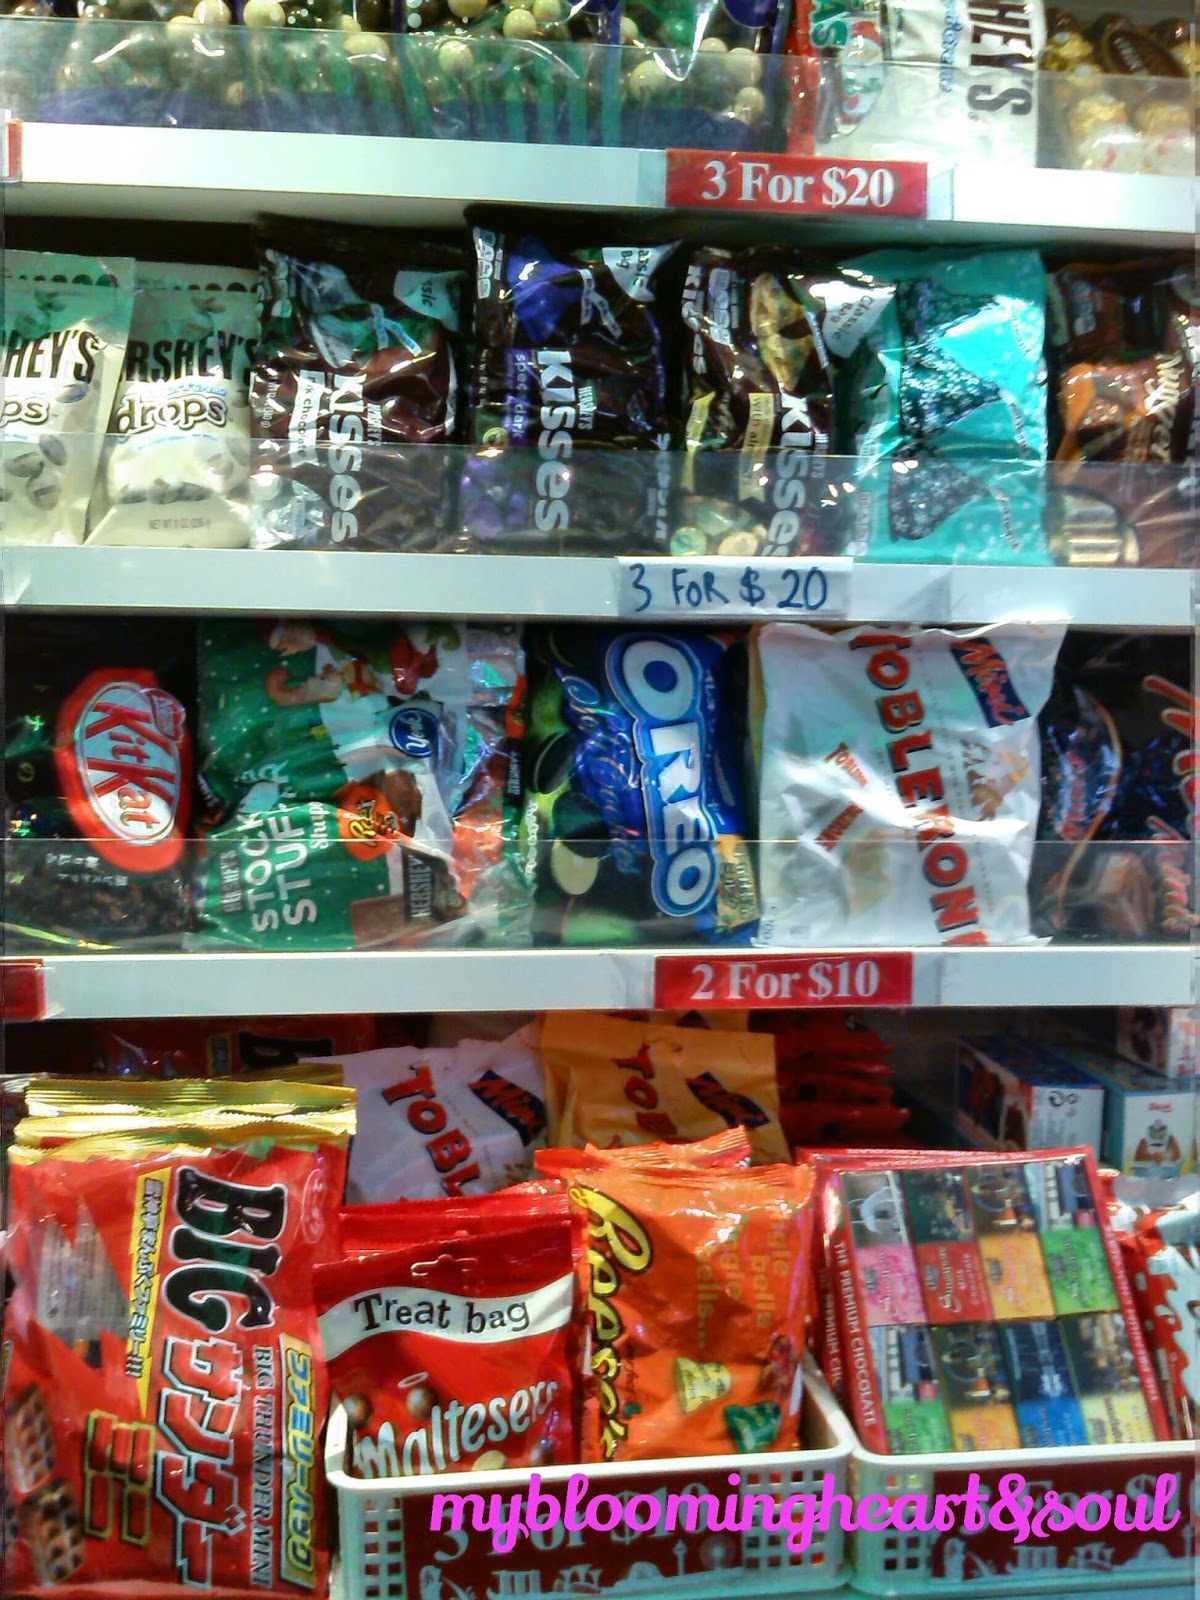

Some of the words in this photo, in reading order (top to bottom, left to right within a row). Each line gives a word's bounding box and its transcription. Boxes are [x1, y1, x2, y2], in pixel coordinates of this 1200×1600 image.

[702, 160, 727, 200] 3
[737, 161, 813, 204] For
[822, 166, 895, 208] $20
[116, 394, 228, 435] drops
[511, 402, 528, 438] dark
[629, 563, 653, 612] 3
[671, 567, 729, 607] FOR
[952, 638, 1027, 727] Mini
[621, 639, 712, 908] OREO
[690, 963, 715, 1000] 2
[725, 961, 801, 1000] For
[808, 959, 881, 1001] $10
[162, 1165, 288, 1334] BIG
[834, 1241, 847, 1265] THE
[354, 1292, 452, 1332] Treat
[465, 1300, 530, 1334] bag
[840, 1269, 860, 1335] PREMIUM
[253, 1344, 275, 1390] BIG
[850, 1335, 877, 1426] CHOCOLATE
[84, 1408, 156, 1547] ミニ
[155, 1335, 247, 1589] サンダー
[251, 1395, 274, 1520] THUNDER
[287, 1346, 315, 1572] ファミリーパック
[250, 1520, 274, 1588] MINI
